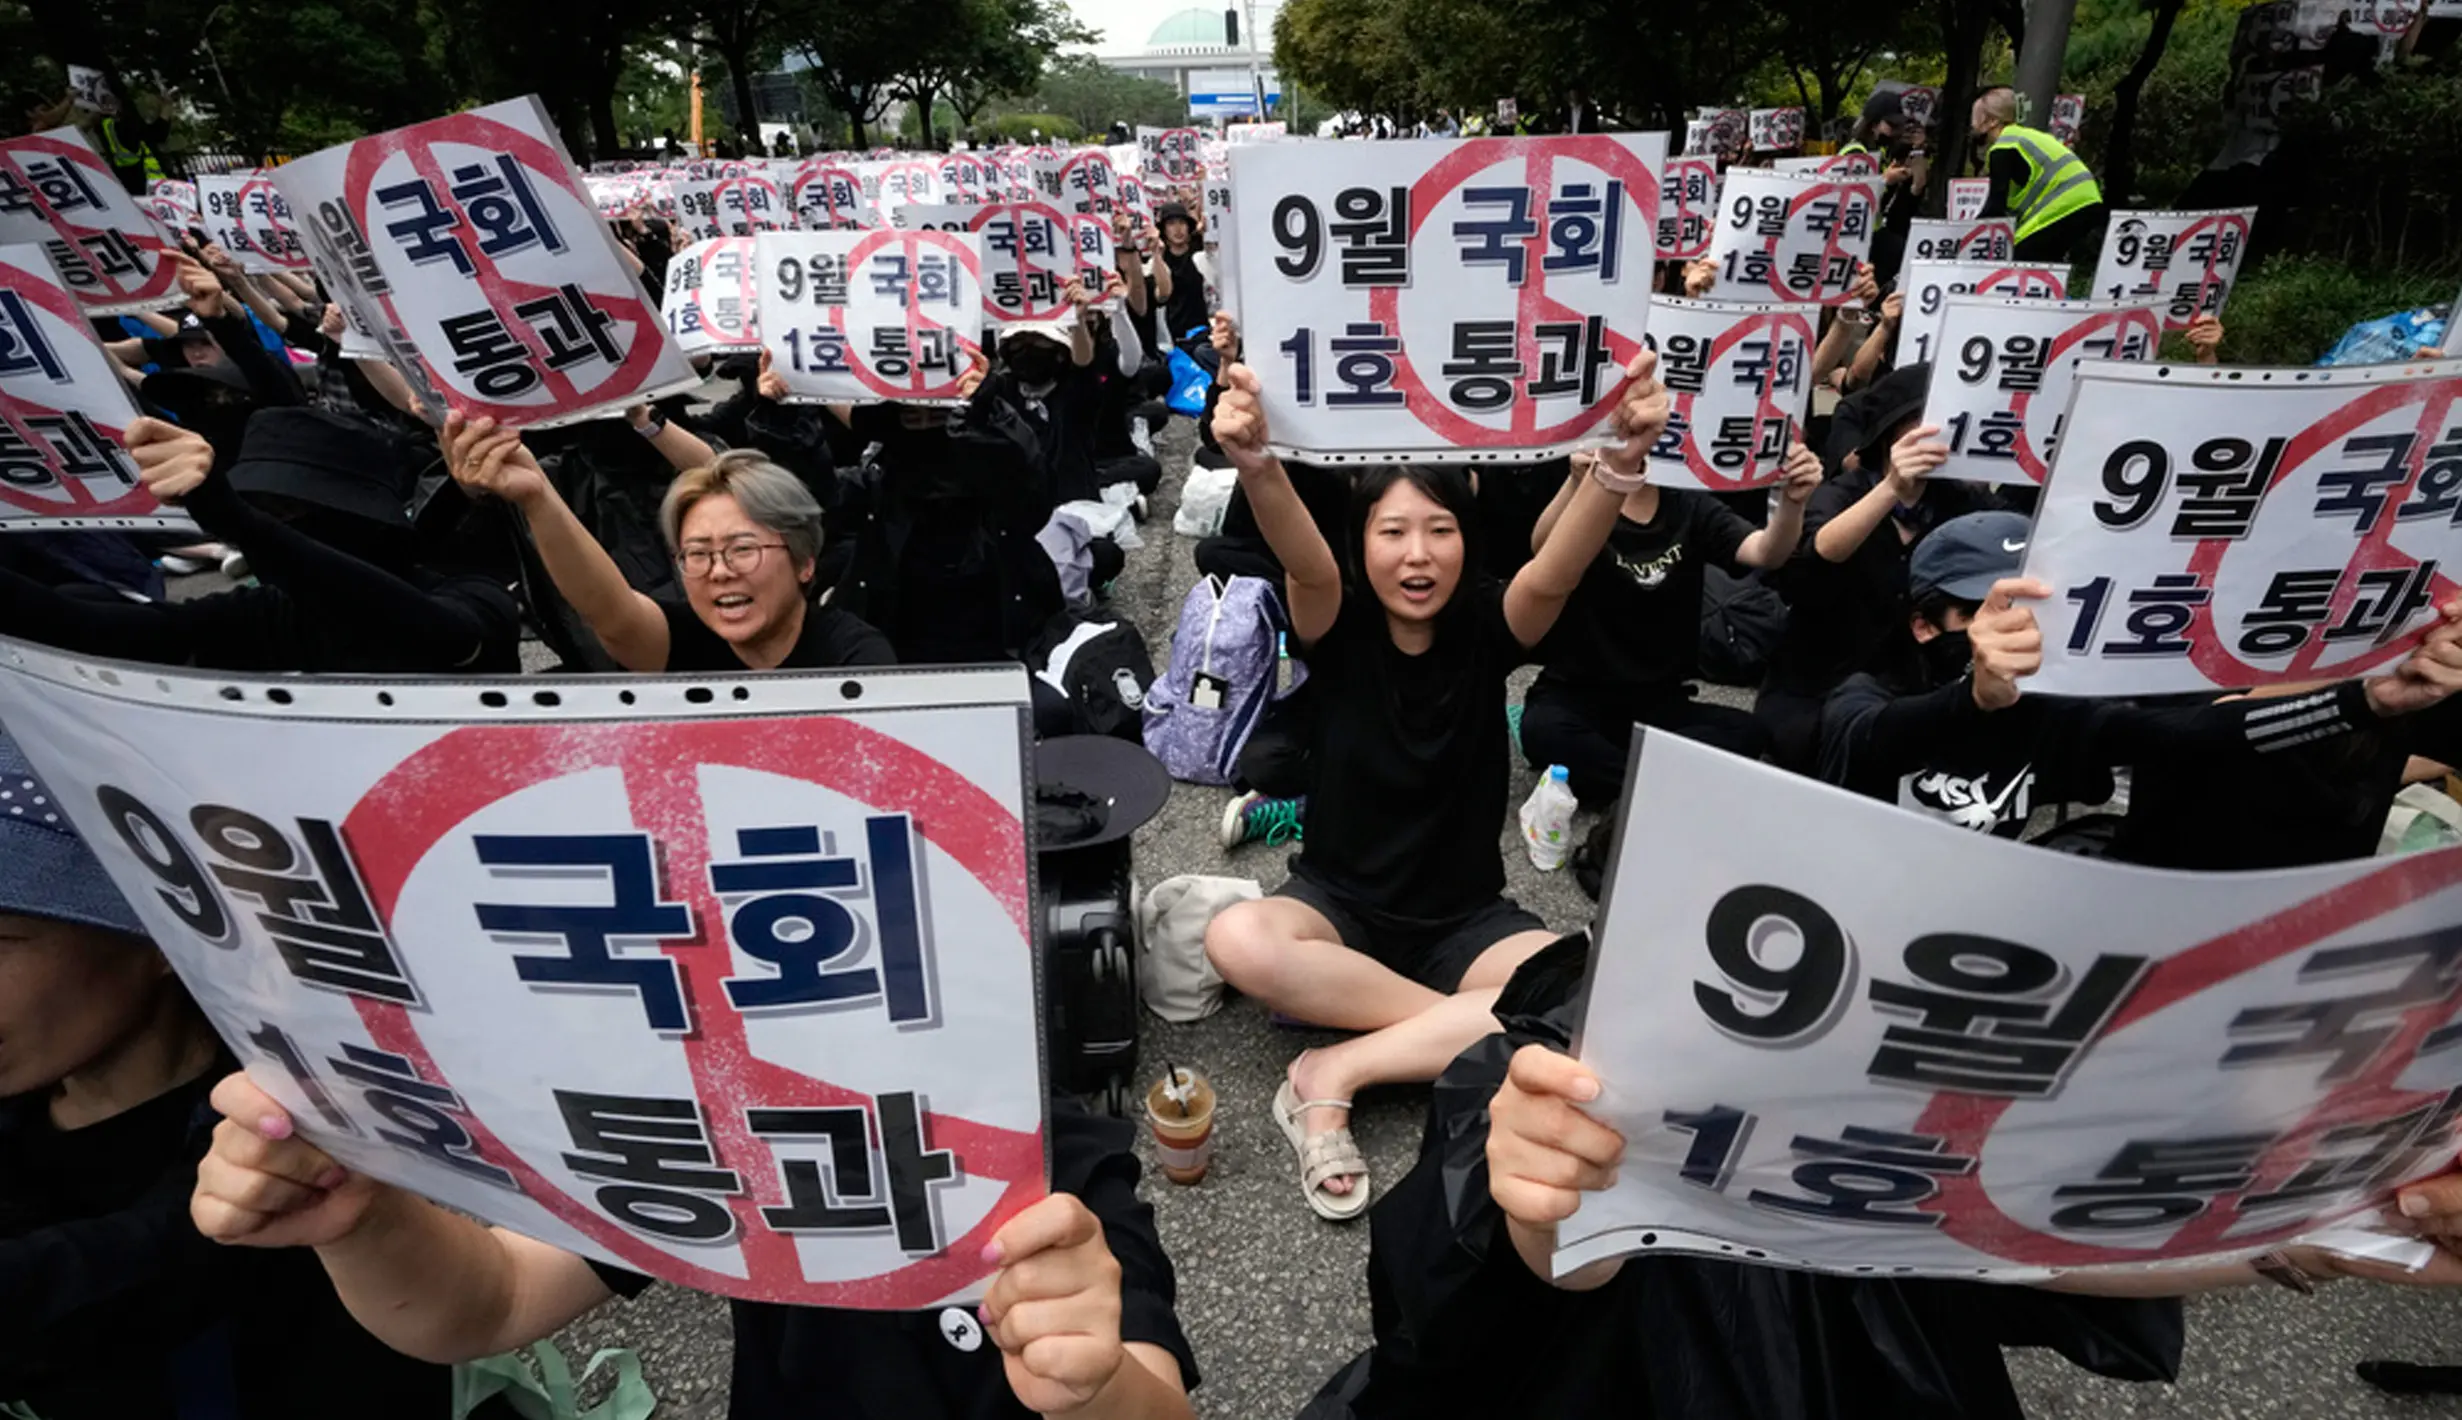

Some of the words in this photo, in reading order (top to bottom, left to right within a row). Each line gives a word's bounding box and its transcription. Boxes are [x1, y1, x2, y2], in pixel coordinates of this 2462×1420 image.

[1142, 135, 1160, 152] 9월
[1167, 136, 1197, 152] 국회
[806, 181, 857, 212] 국회
[942, 165, 978, 186] 국회
[1035, 170, 1063, 196] 9월
[1070, 162, 1109, 191] 국회
[1662, 173, 1707, 206] 국회
[208, 190, 243, 218] 9월
[250, 193, 294, 221] 국회
[374, 153, 571, 278] 국회
[682, 191, 718, 216] 9월
[725, 188, 770, 212] 국회
[1731, 195, 1793, 239] 9월
[1805, 201, 1870, 242] 국회
[218, 228, 257, 252] 1호
[987, 219, 1056, 258] 국회
[1272, 186, 1412, 287] 9월
[1452, 179, 1626, 286] 국회
[1657, 214, 1706, 248] 통과
[1916, 239, 1960, 260] 9월
[2116, 234, 2177, 270] 9월
[2189, 231, 2241, 269] 국회
[46, 227, 150, 287] 통과
[670, 255, 703, 293] 9월
[777, 253, 849, 306] 9월
[870, 254, 962, 307] 국회
[1723, 249, 1774, 286] 1호
[1788, 252, 1860, 291] 통과
[993, 269, 1060, 307] 통과
[2170, 280, 2226, 316] 통과
[439, 282, 626, 398] 통과
[668, 302, 703, 335] 1호
[783, 326, 851, 374] 1호
[870, 325, 961, 377] 통과
[1281, 321, 1408, 408] 1호
[1442, 314, 1611, 411] 통과
[1644, 333, 1712, 395] 월
[1732, 338, 1804, 397] 국회
[1958, 336, 2052, 392] 9월
[1650, 412, 1689, 463] 호
[1711, 414, 1793, 468] 통과
[1948, 411, 2023, 459] 1호
[2093, 437, 2290, 540] 9월
[2067, 573, 2213, 658] 1호
[2238, 560, 2440, 655] 통과
[95, 782, 426, 1013] 9월
[471, 812, 943, 1036] 국회
[1694, 882, 2160, 1100] 9월
[2218, 925, 2462, 1087] 국
[247, 1022, 521, 1192] 1호
[550, 1088, 967, 1257] 통과
[1661, 1103, 1979, 1228] 1호
